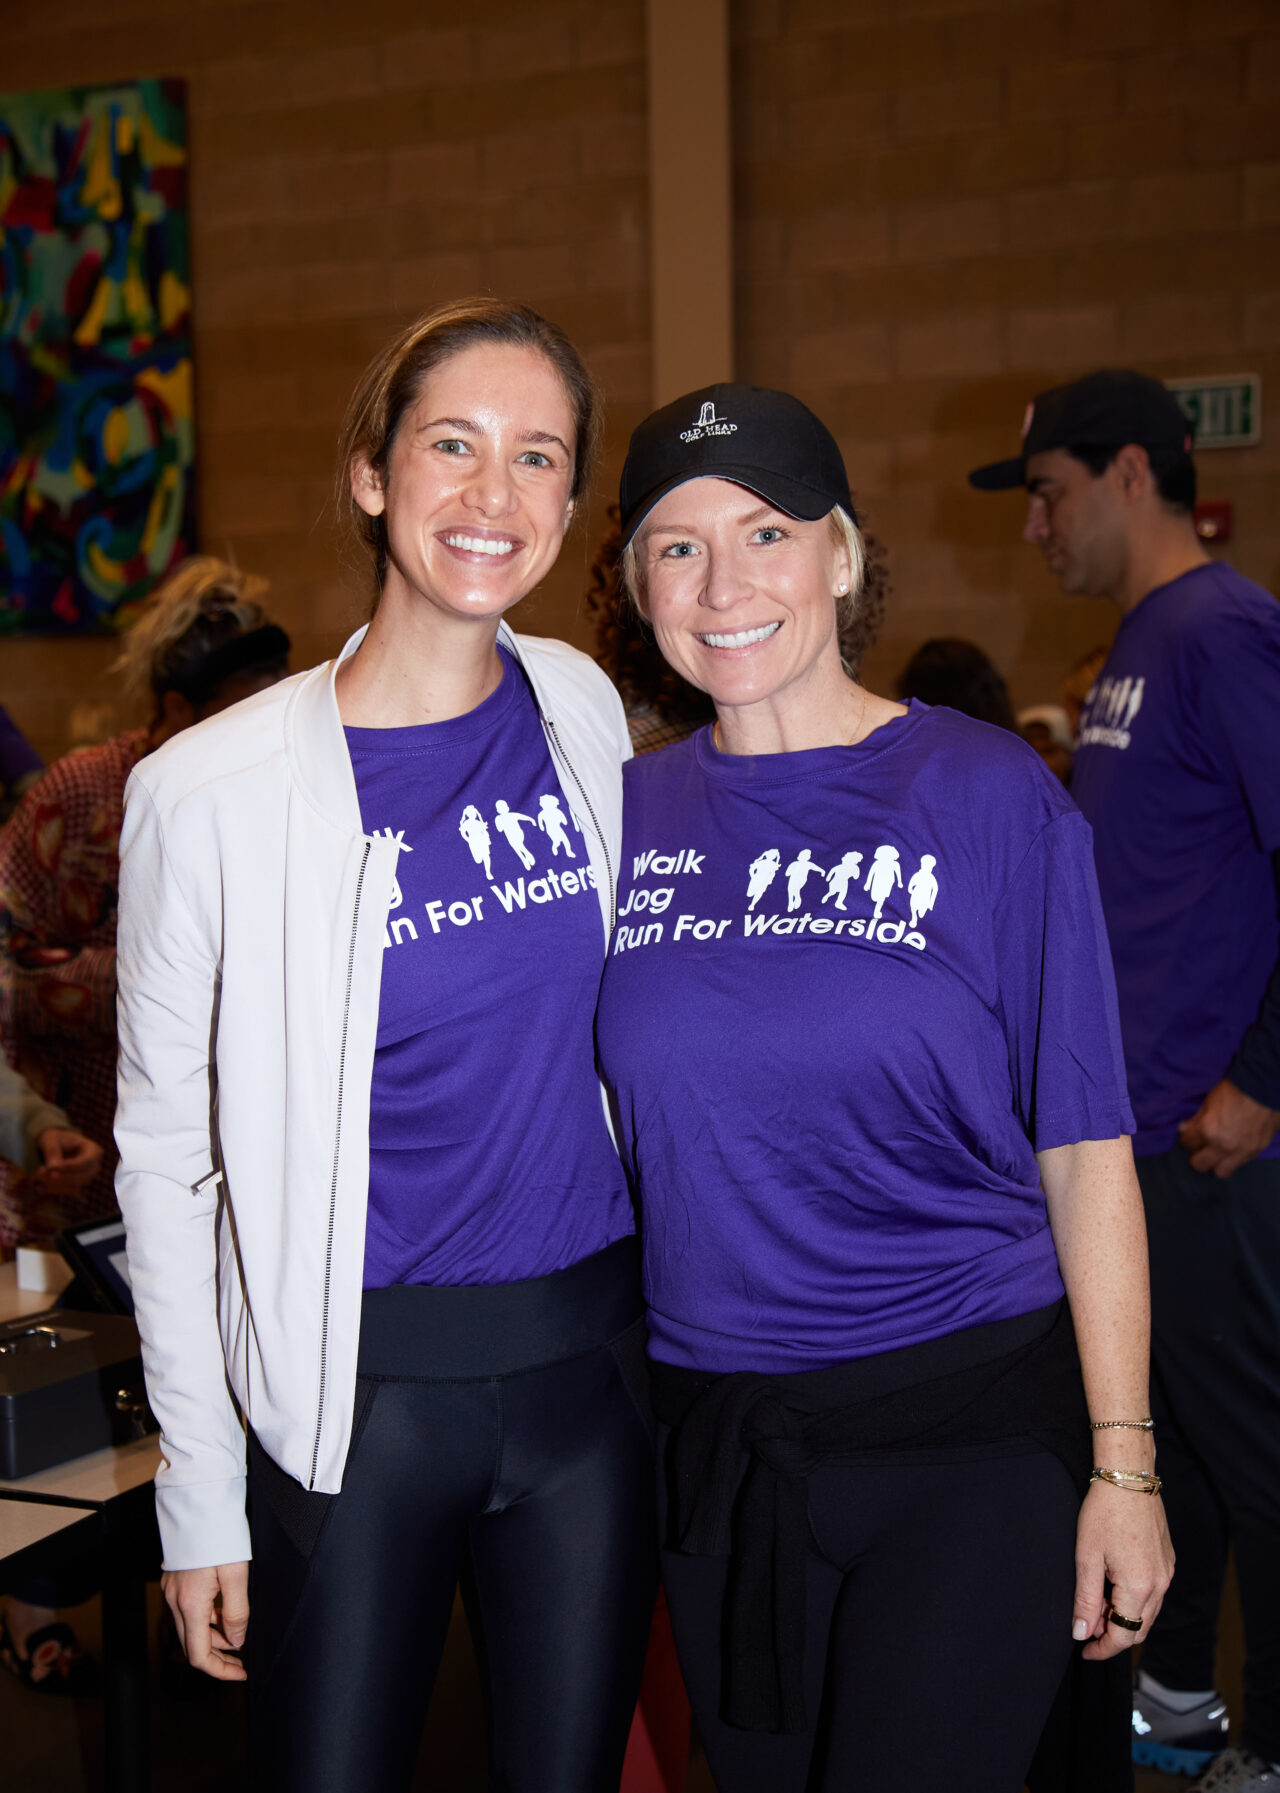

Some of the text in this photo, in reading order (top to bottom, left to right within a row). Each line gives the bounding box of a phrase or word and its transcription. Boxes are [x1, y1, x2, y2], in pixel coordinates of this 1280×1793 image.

[680, 423, 738, 440] OLD HEAD
[633, 849, 706, 880] Walk
[424, 896, 484, 934] For
[489, 865, 597, 914] Waters
[618, 888, 675, 917] Jog
[613, 913, 927, 956] Run For Waterside
